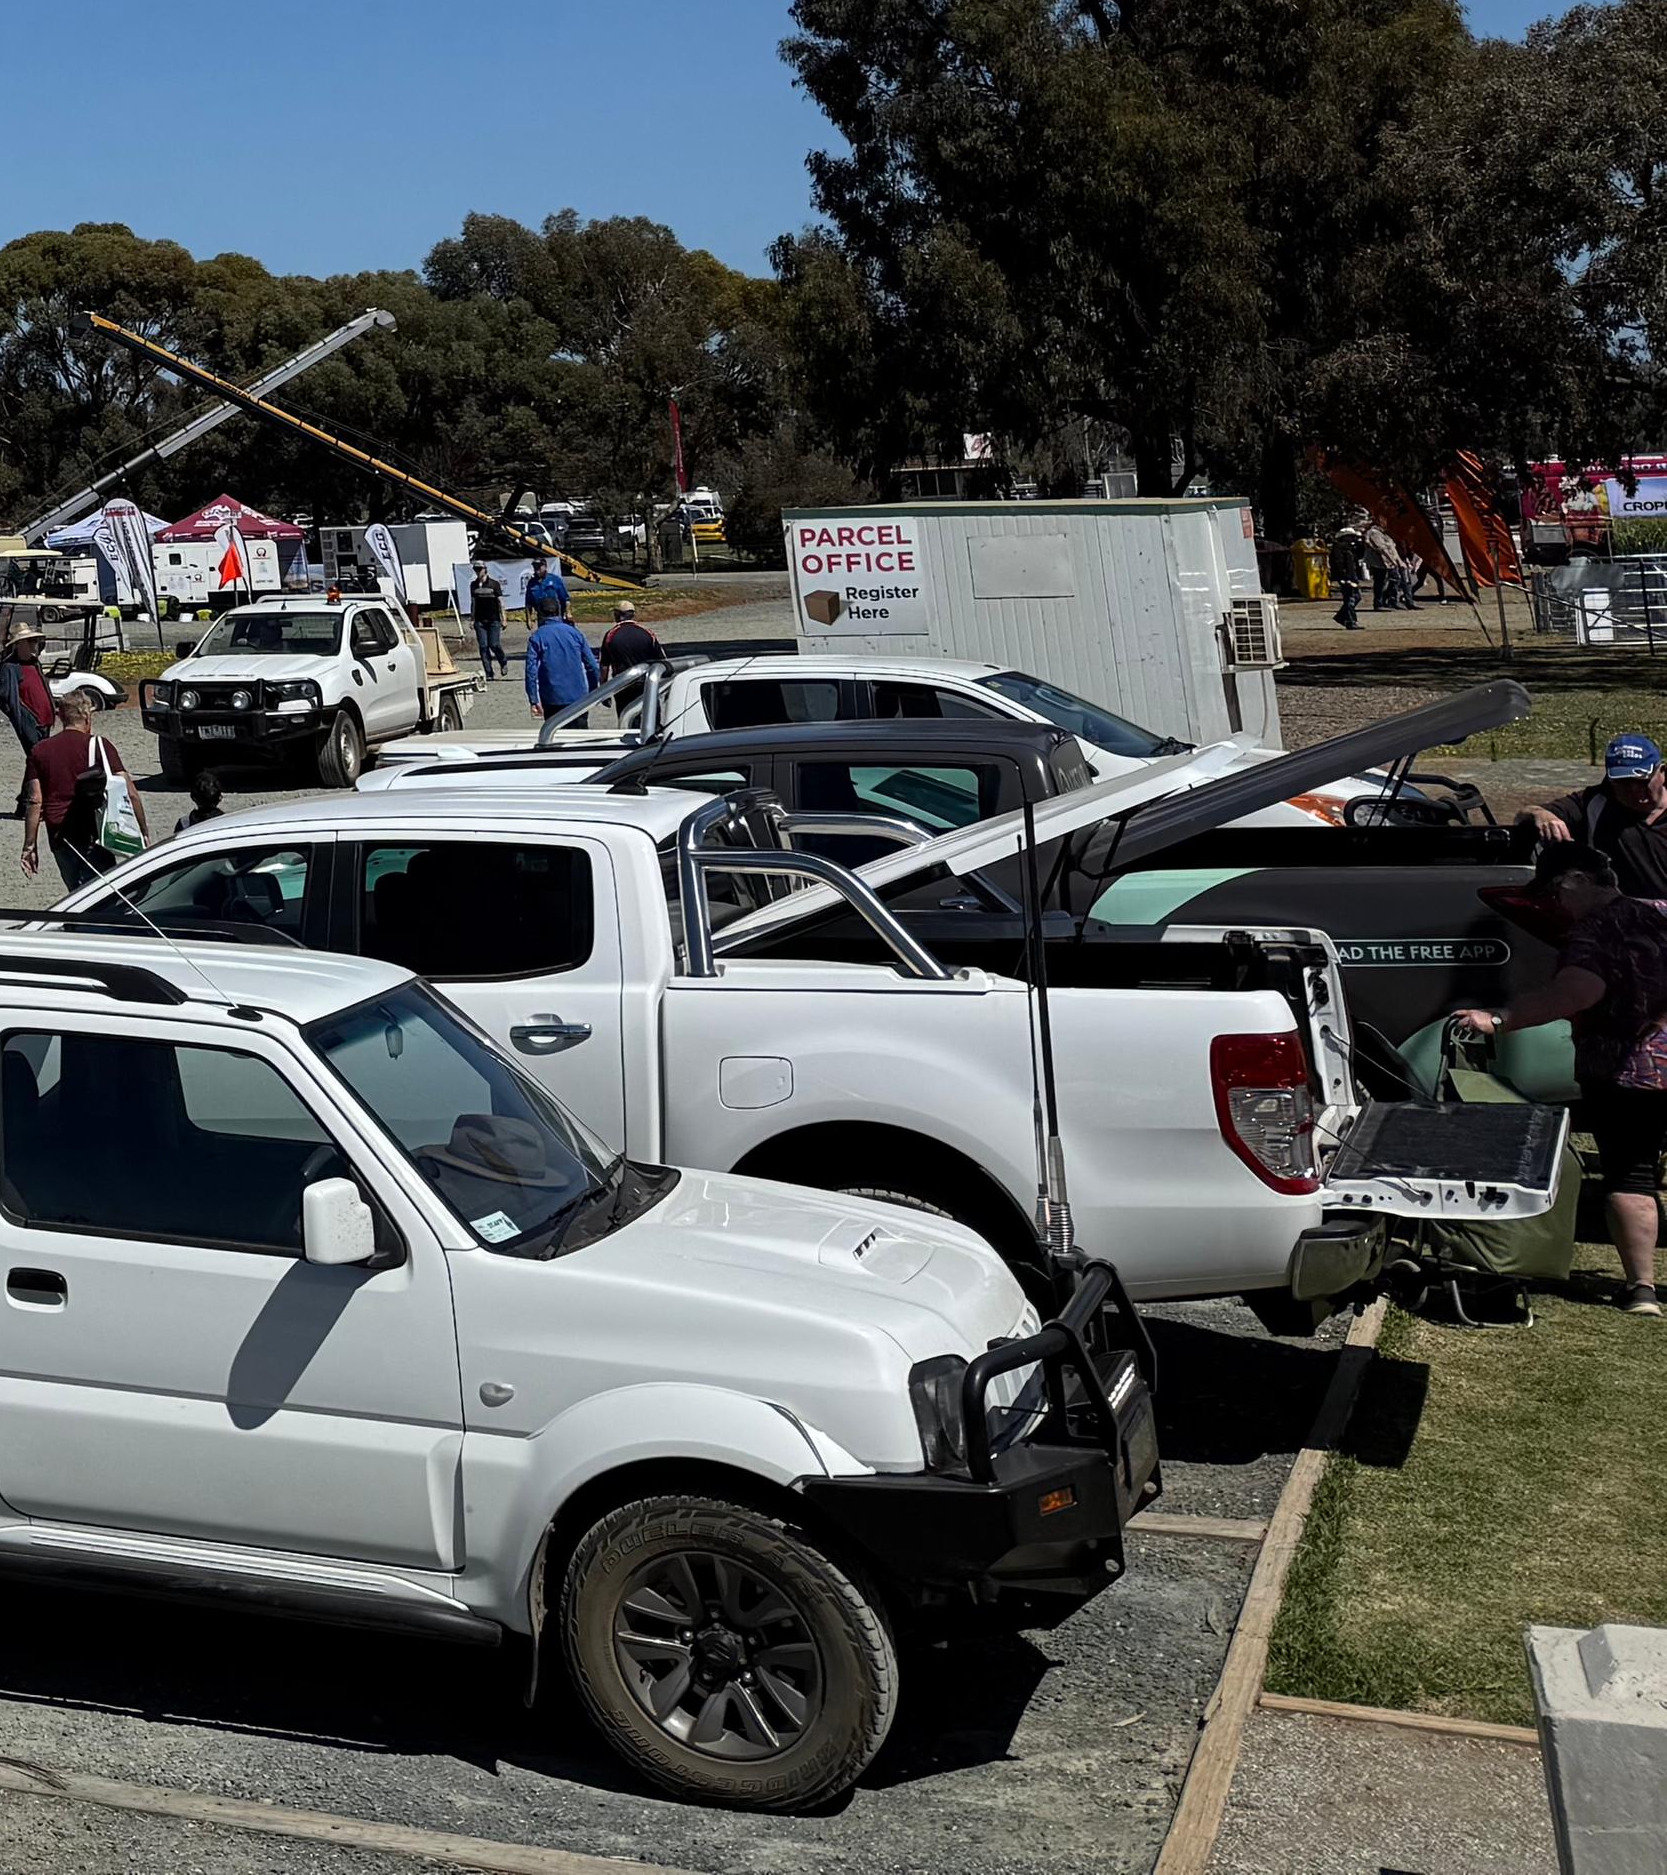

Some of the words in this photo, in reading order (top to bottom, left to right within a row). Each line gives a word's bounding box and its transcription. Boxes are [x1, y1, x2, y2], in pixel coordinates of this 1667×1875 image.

[799, 525, 912, 548] PARCEL
[801, 551, 915, 575] OFFICE
[845, 585, 919, 602] Register
[848, 606, 890, 619] Here
[1367, 946, 1405, 960] THE
[1410, 945, 1455, 959] FREE
[1459, 945, 1496, 959] APP
